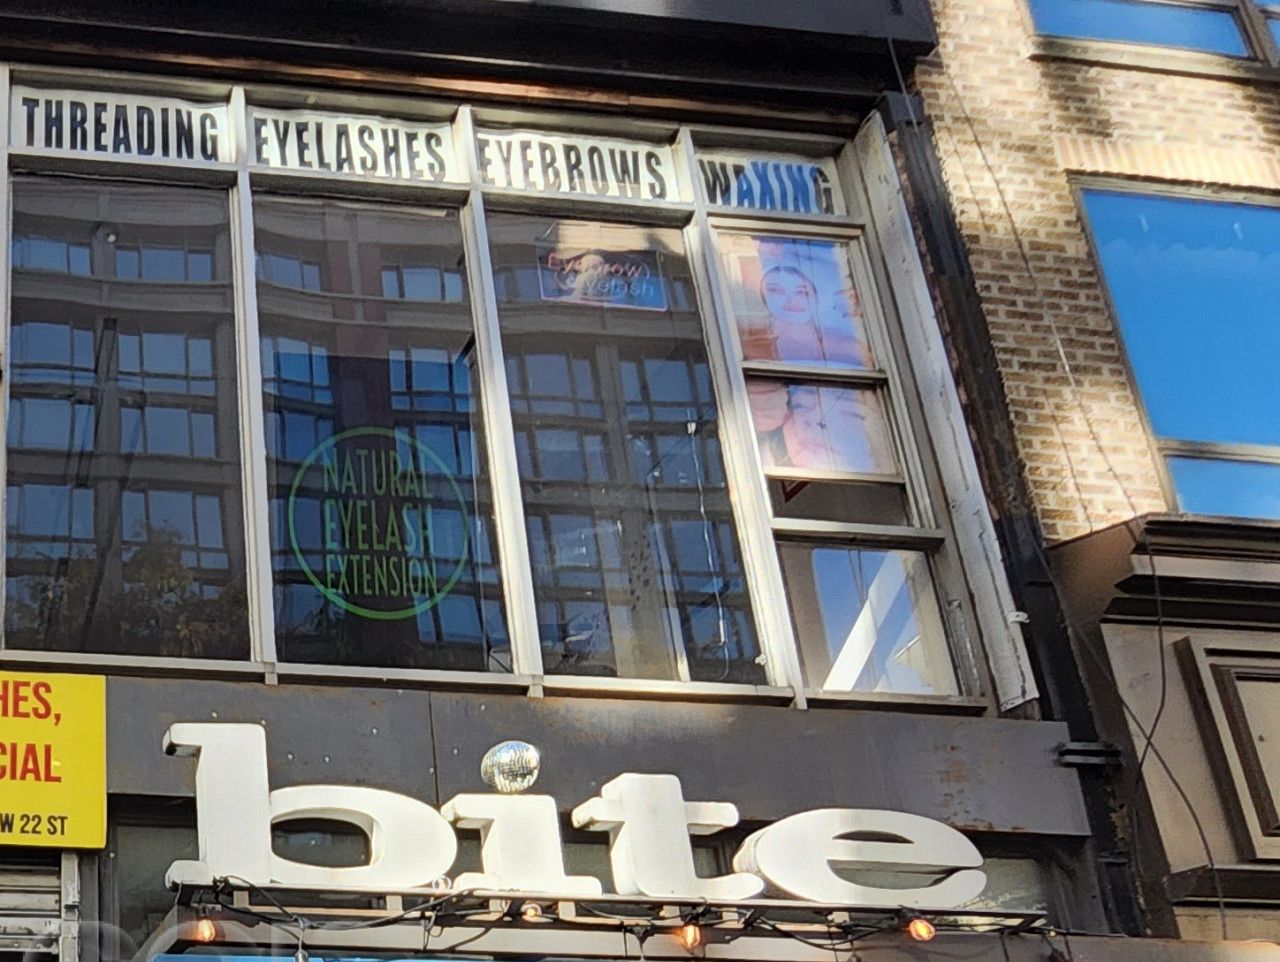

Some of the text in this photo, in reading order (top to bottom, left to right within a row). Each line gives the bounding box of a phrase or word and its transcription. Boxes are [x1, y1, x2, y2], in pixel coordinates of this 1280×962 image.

[21, 97, 219, 162] THREADING
[253, 115, 446, 181] EYELASHES
[477, 133, 666, 200] EYEBROWS
[700, 158, 835, 215] WAXING
[323, 449, 434, 499] NATURAL
[324, 498, 434, 557] EYELASH
[326, 553, 438, 598] EXTENSION
[0, 812, 16, 833] W
[20, 814, 42, 835] 22
[46, 815, 69, 836] ST
[162, 722, 988, 910] bite
